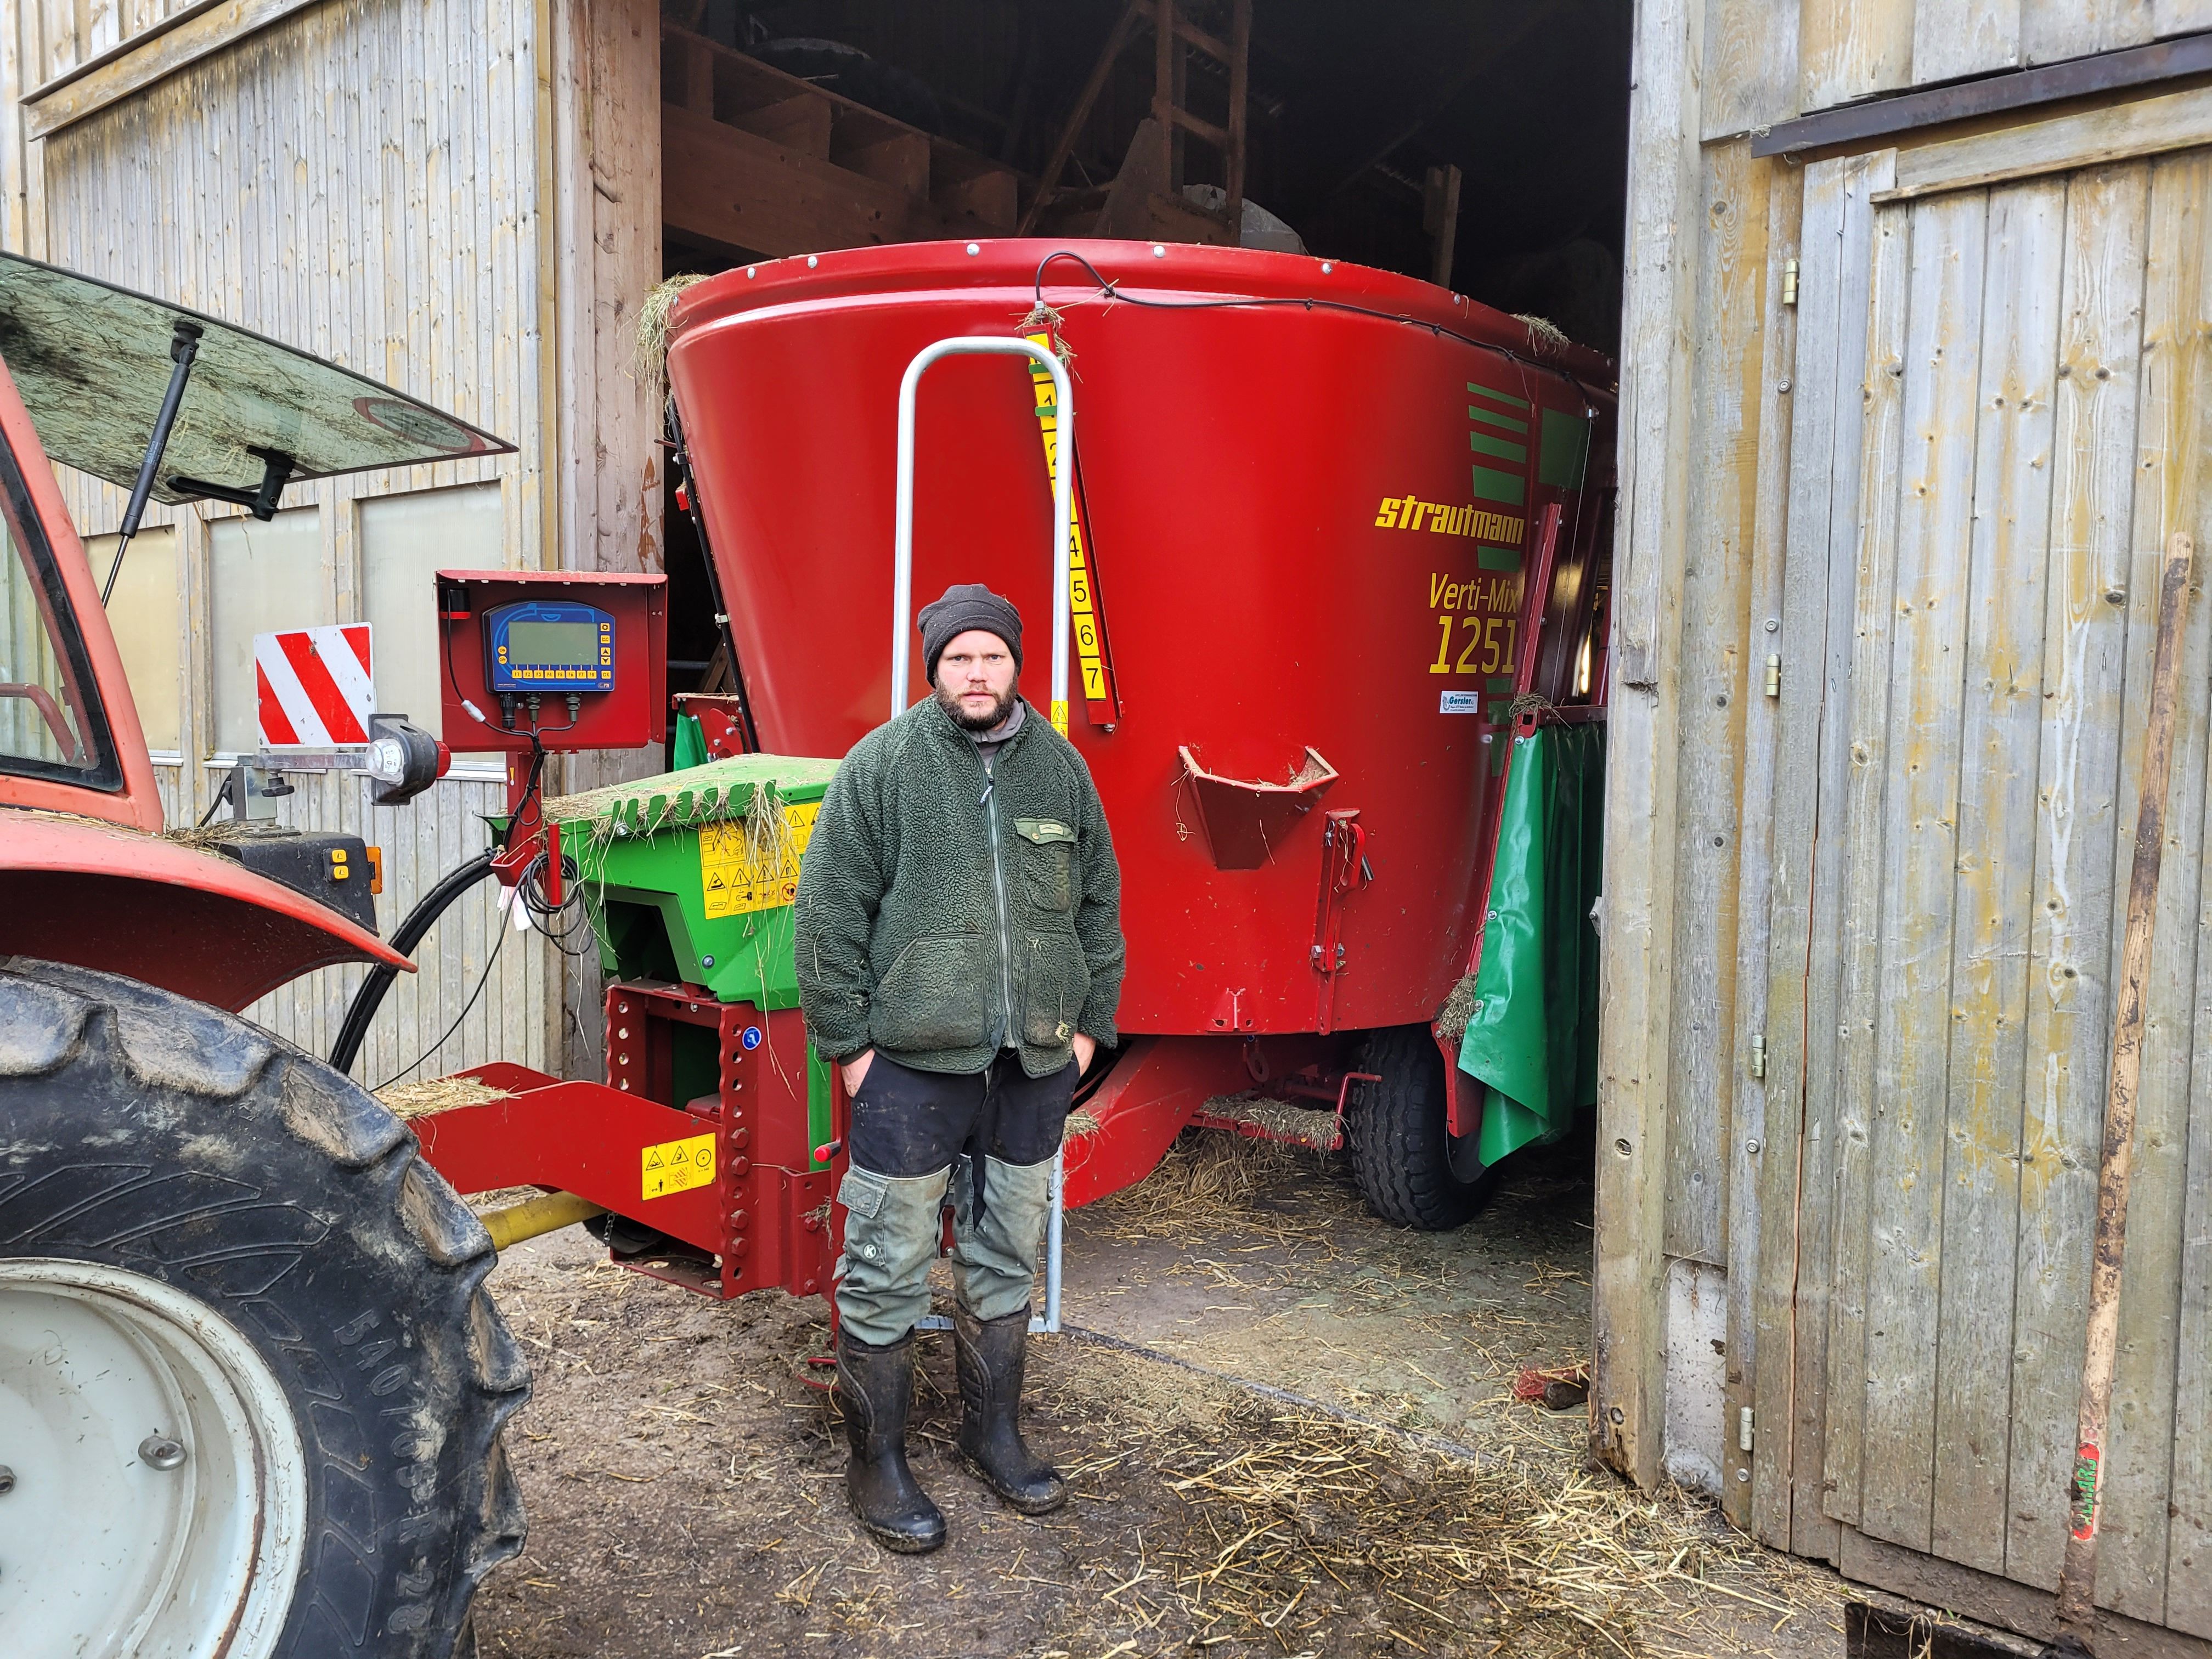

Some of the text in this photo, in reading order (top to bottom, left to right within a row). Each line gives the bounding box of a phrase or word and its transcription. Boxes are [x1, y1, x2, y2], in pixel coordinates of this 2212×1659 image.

[1374, 495, 1525, 544] strautmann
[1070, 535, 1080, 557] 4
[1073, 580, 1087, 602] 5
[1430, 572, 1518, 613] Verti-Mix
[1080, 624, 1094, 646] 6
[1429, 616, 1516, 674] 1251
[1085, 668, 1098, 689] 7
[1449, 696, 1471, 704] Gerster
[865, 1245, 875, 1257] K
[388, 1568, 435, 1634] 28
